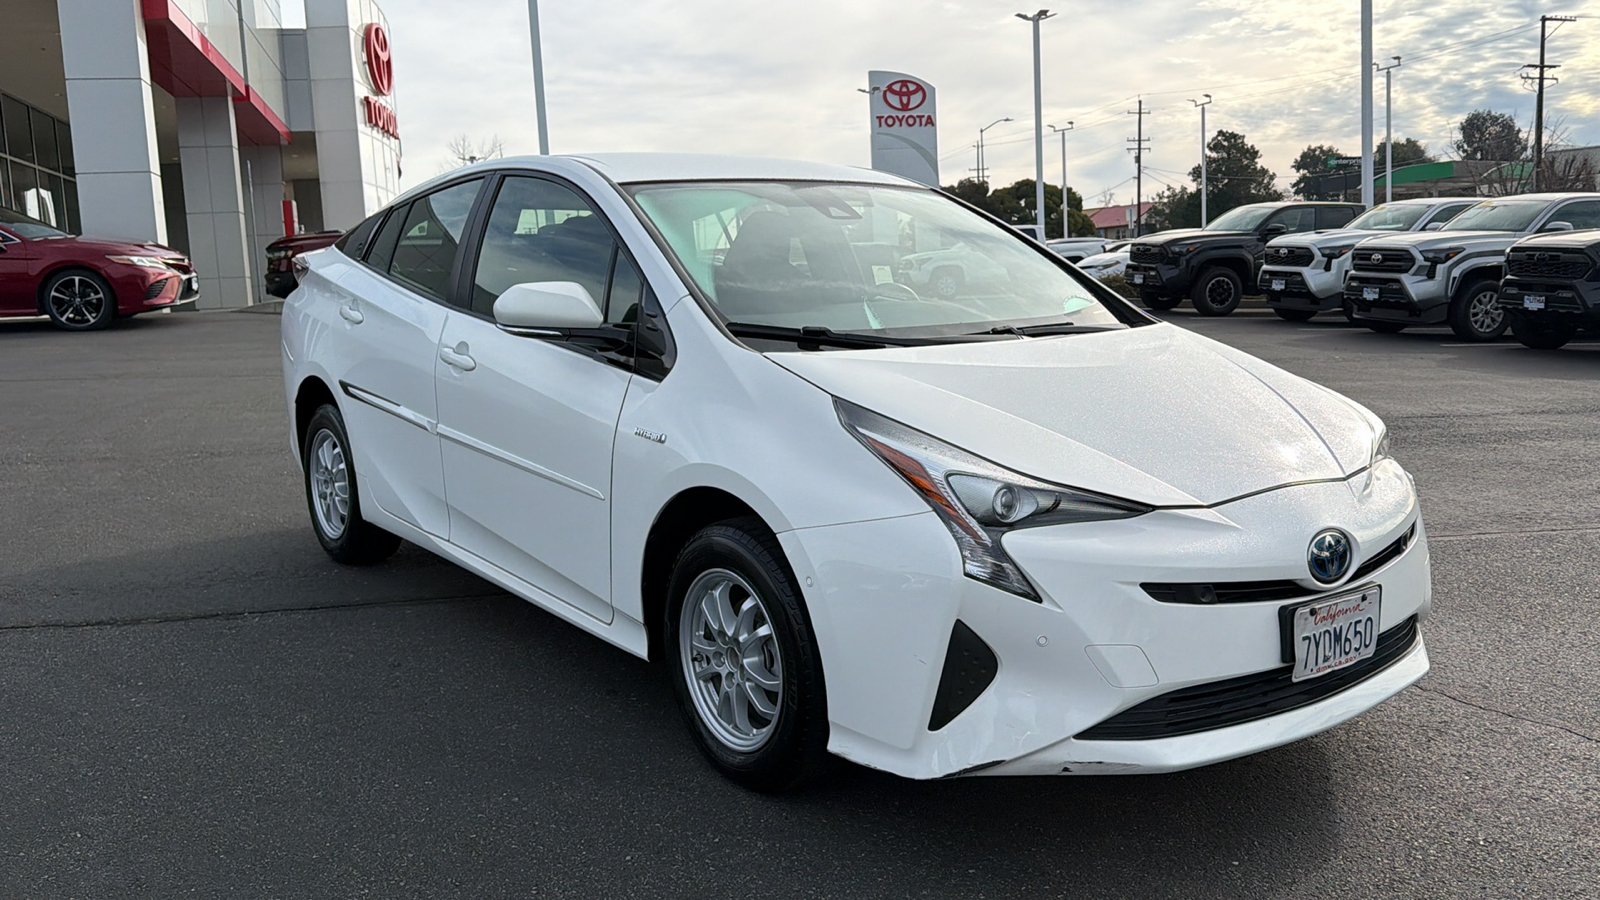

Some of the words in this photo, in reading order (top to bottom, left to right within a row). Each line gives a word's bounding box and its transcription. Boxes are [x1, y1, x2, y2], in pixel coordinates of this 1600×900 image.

[876, 114, 935, 128] TOYOTA
[1314, 602, 1365, 626] California
[1302, 616, 1373, 670] 7YDM650
